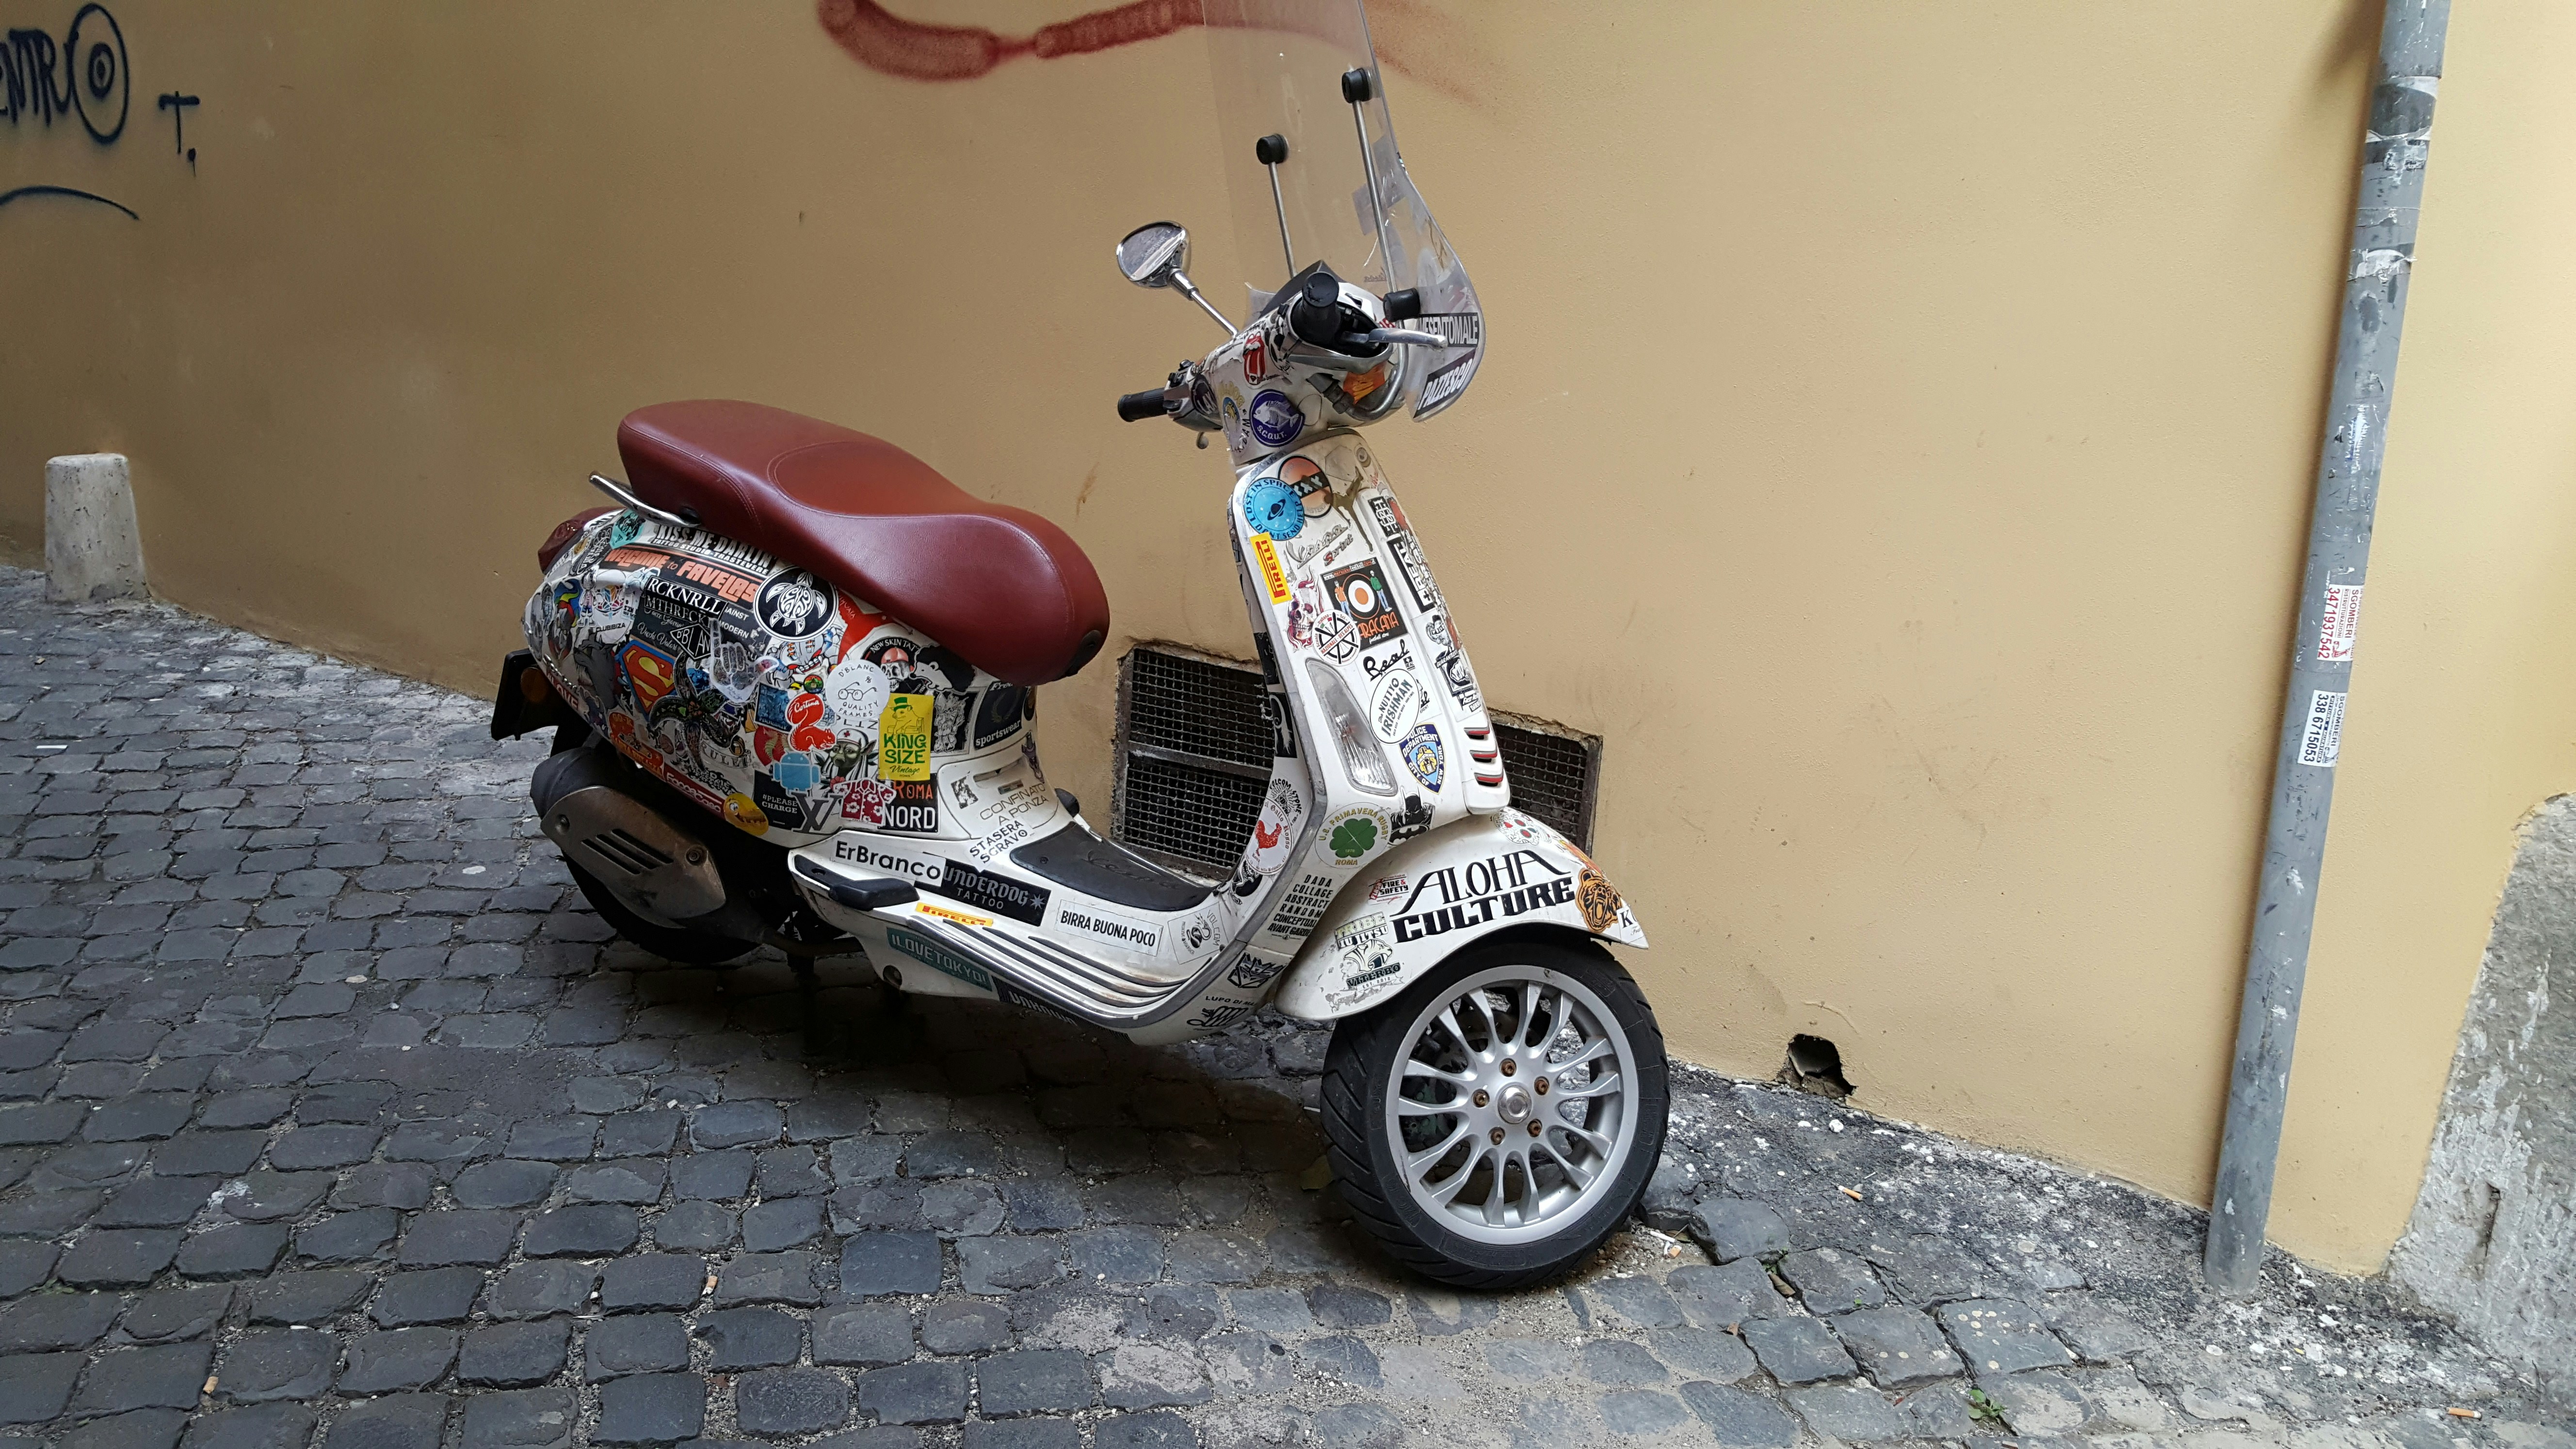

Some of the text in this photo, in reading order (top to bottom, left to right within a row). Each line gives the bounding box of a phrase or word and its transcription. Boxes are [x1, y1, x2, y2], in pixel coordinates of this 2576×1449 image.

[1417, 358, 1473, 410] PAZZESCO
[1263, 479, 1298, 499] SPACE
[1283, 524, 1301, 539] SEND
[1294, 500, 1304, 524] HELP
[653, 538, 680, 548] TATTOO
[1286, 524, 1349, 568] Vespa
[1323, 533, 1354, 566] Sprint
[1255, 540, 1286, 598] PIRELLI
[666, 561, 678, 571] to
[676, 561, 761, 603] FAVELAS
[647, 578, 723, 615] RCKNRLL
[2318, 587, 2340, 659] 3471937542
[2337, 588, 2349, 638] RISTRUTTURAZIONI
[2345, 589, 2359, 638] SGOMBERI
[596, 622, 626, 632] CLUBIBIZA
[719, 620, 750, 639] MODERN
[1320, 637, 1338, 654] NAZIONALE
[1343, 623, 1353, 635] ALPES
[1357, 612, 1400, 640] ARACANA
[676, 628, 711, 657] D'BLAN
[869, 640, 885, 654] NEW
[884, 638, 902, 647] SKIN
[838, 664, 874, 677] D'BLANC
[794, 697, 820, 713] Cortina
[842, 700, 879, 711] QUALITY
[1378, 684, 1395, 713] NUTTY
[1381, 678, 1413, 737] IRISHMAN
[1420, 705, 1429, 714] ERENT
[838, 708, 873, 717] FRAMES
[2330, 695, 2345, 747] SGOMBERI
[976, 720, 1021, 747] sportswear
[1406, 725, 1428, 742] POLICE
[2303, 693, 2329, 763] 338 6715053
[884, 733, 927, 749] KING
[1402, 733, 1439, 758] DEPARTMENT
[884, 749, 926, 765] SIZE
[889, 765, 920, 776] Vintage
[1408, 762, 1421, 778] CITY
[762, 793, 798, 807] #PLEASE
[893, 780, 934, 800] ROMA
[979, 783, 1046, 820] CONFINATO
[761, 800, 798, 815] CHARGE
[885, 805, 936, 829] NORD
[998, 795, 1049, 826] A PONZA
[1329, 807, 1378, 826] PRIMAVERA
[1376, 815, 1387, 841] RUGBY
[970, 820, 1024, 857] STASERA
[980, 829, 1028, 864] SGRAVO
[835, 840, 941, 880] ErBranco
[943, 866, 1030, 906] UNDERDOG
[1292, 884, 1334, 899] COLLAGE
[1304, 874, 1333, 887] DADA
[1380, 885, 1409, 895] SAFETY
[1383, 880, 1401, 888] FIRE
[1390, 850, 1571, 918] ALOHA
[956, 887, 1004, 910] TATTOO
[1279, 903, 1323, 918] RANDOM
[1284, 893, 1331, 909] ABSTRACT
[1389, 876, 1575, 944] CULTURE
[922, 905, 986, 926] PIRELLI
[1207, 909, 1221, 946] VOLCOM
[1267, 922, 1291, 934] AVANT
[1273, 913, 1318, 928] CONCEPTUAL
[1336, 912, 1387, 940] TRIBE
[1060, 910, 1156, 947] BIRRA BUONA POCO
[1347, 963, 1401, 987] VITERBO
